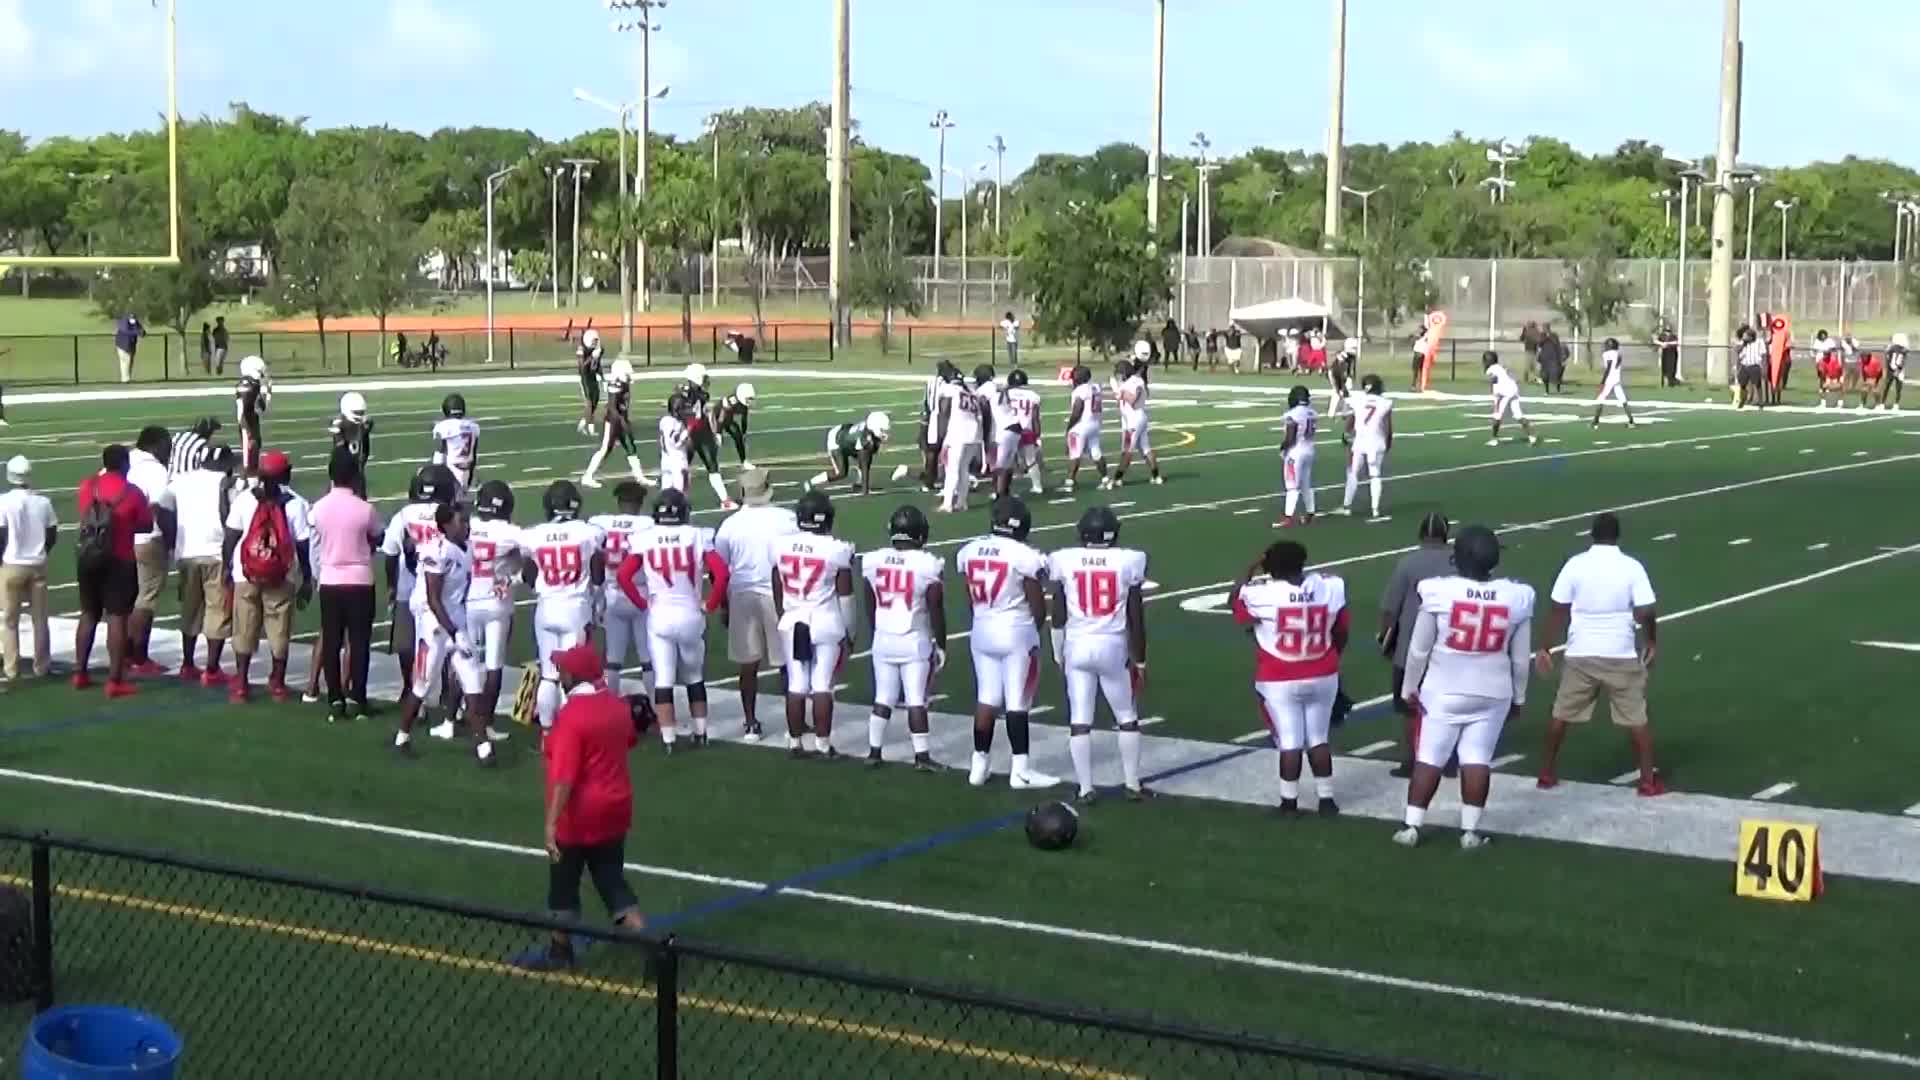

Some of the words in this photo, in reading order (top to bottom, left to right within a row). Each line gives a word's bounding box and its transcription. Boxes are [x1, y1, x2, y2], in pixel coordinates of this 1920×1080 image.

[1364, 404, 1377, 425] 7
[648, 545, 696, 588] 44
[780, 555, 826, 601] 27
[875, 567, 915, 611] 24
[1073, 570, 1119, 618] 18
[1466, 588, 1497, 601] DADE
[1275, 604, 1329, 654] 59
[1444, 602, 1509, 653] 56
[1743, 826, 1806, 894] 40
